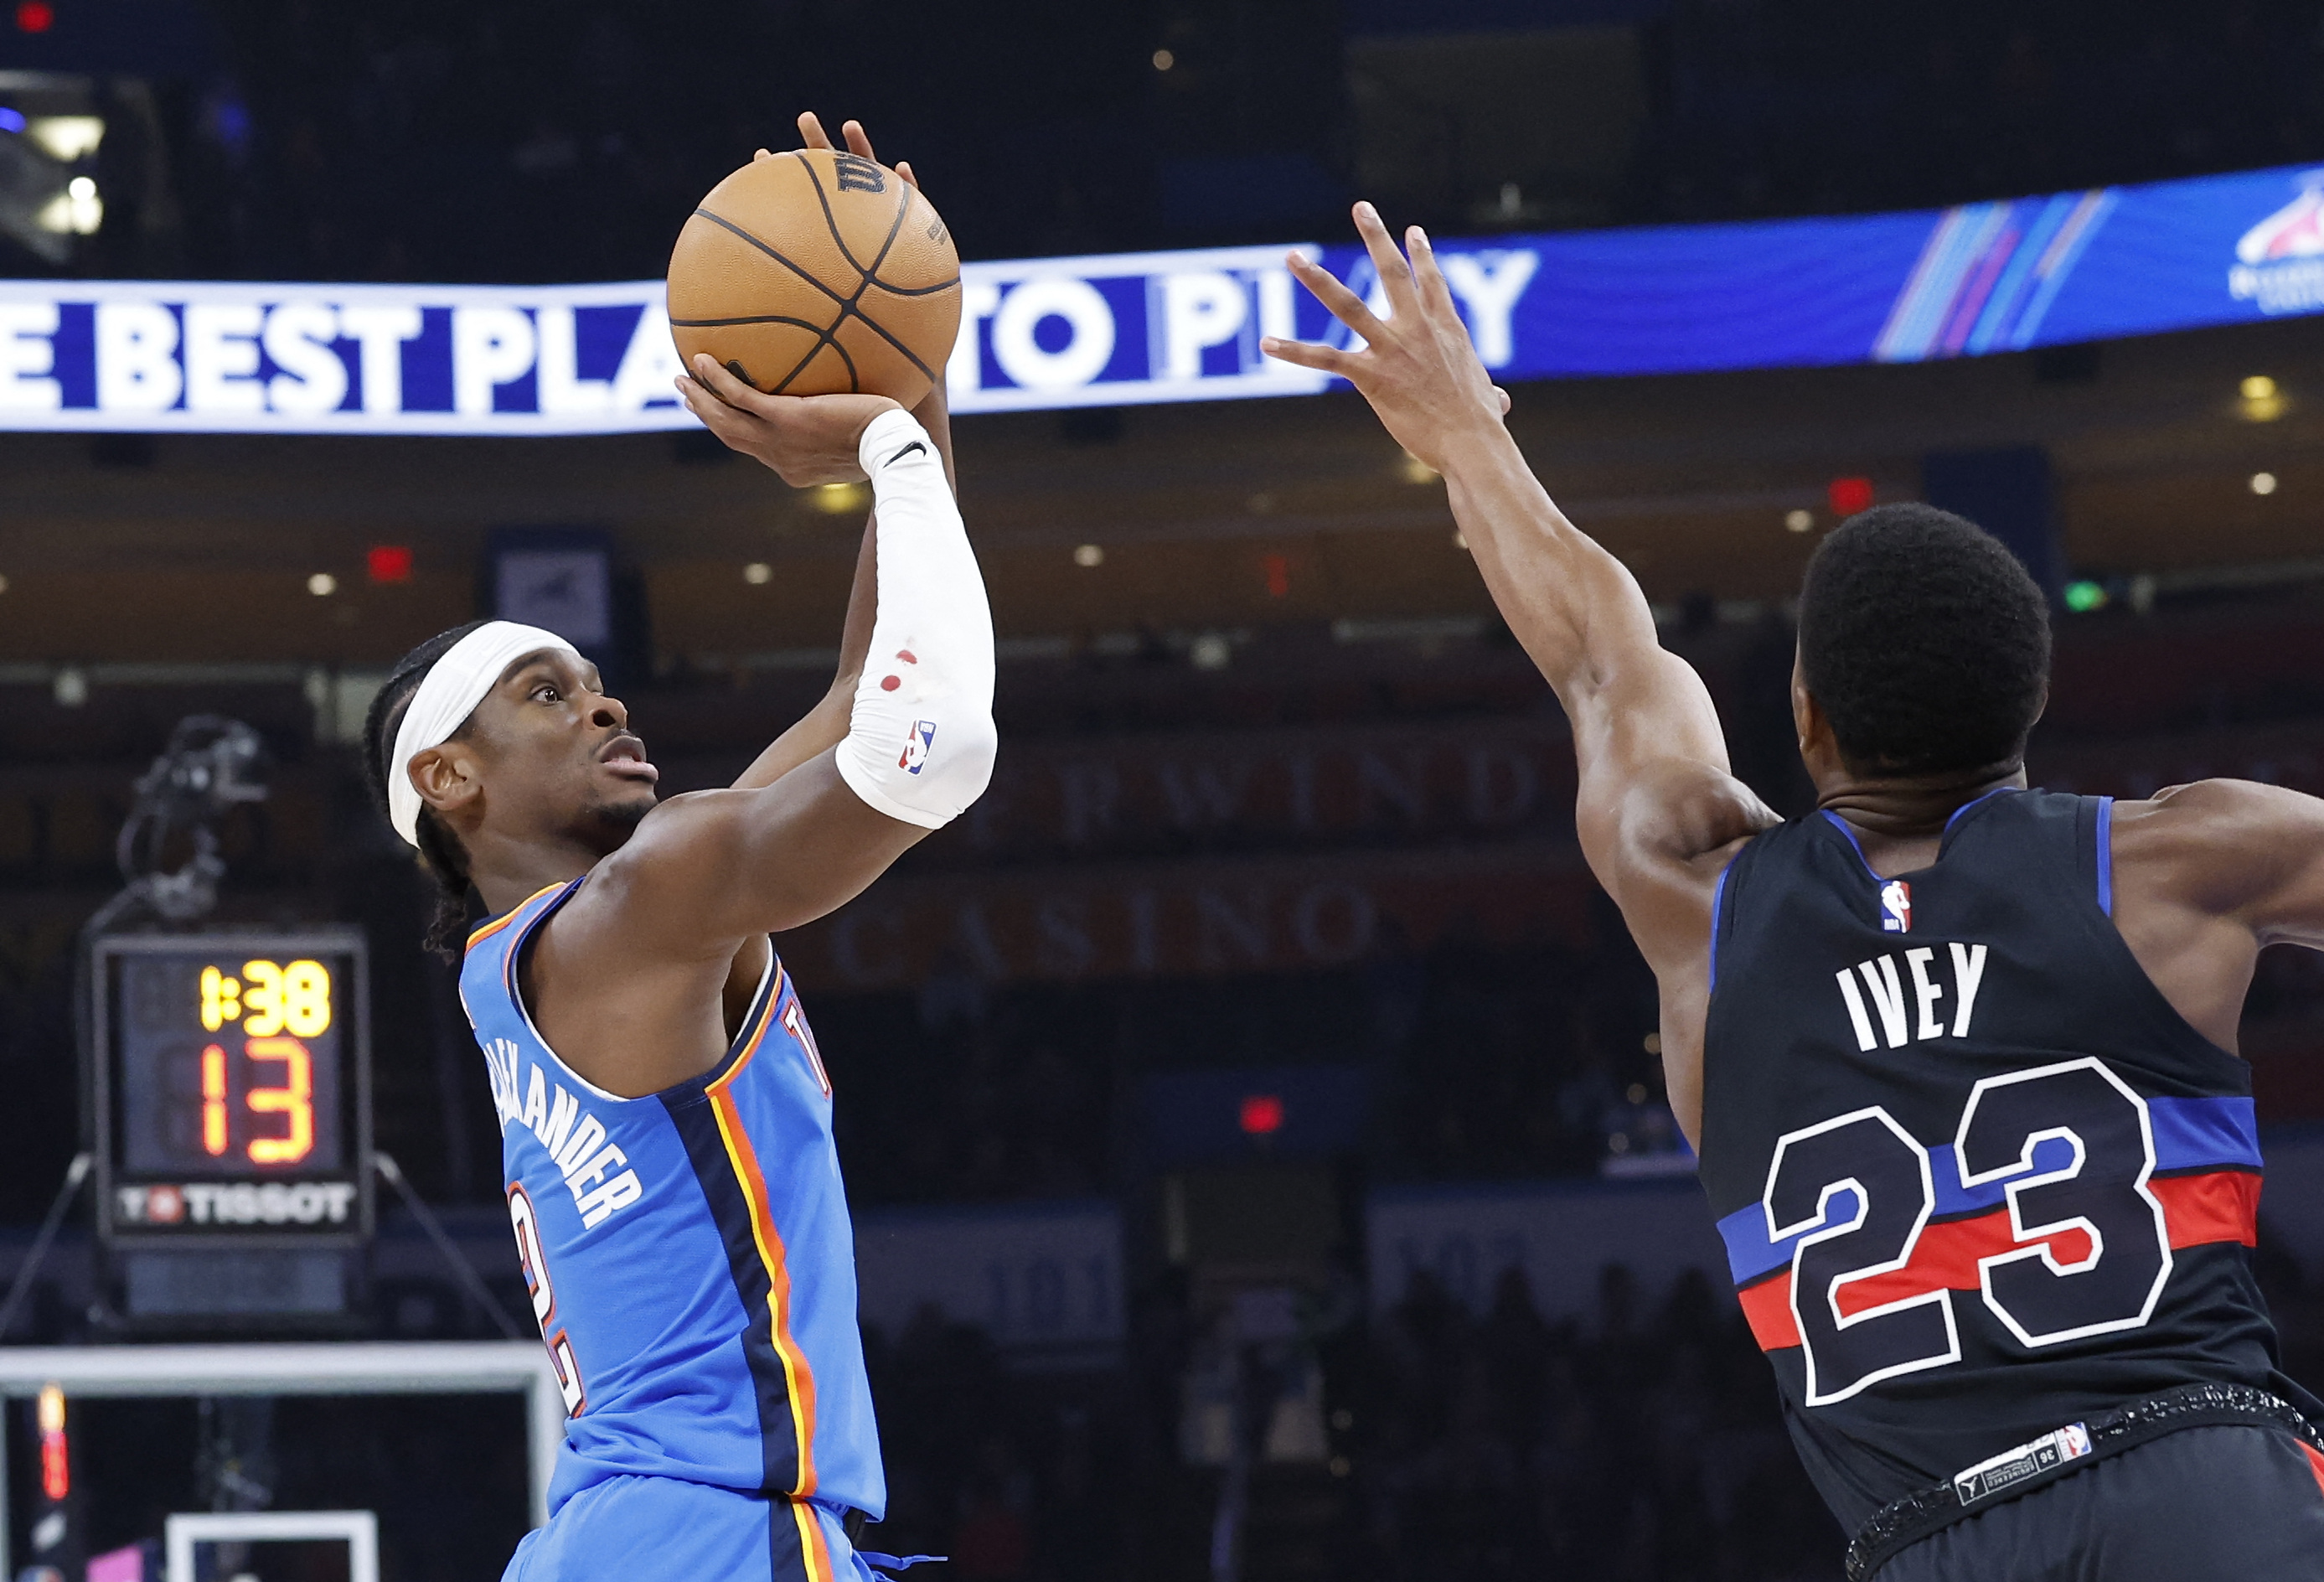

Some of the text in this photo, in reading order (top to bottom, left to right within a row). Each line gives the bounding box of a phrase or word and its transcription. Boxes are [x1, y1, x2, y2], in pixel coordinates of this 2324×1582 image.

[94, 302, 424, 414] BEST
[453, 302, 689, 416] PLA
[826, 881, 1377, 987] CASINO
[200, 959, 332, 1038] 1:38
[1836, 942, 1988, 1052] IVEY
[201, 1037, 315, 1165] 13
[183, 1182, 357, 1224] TISSOT
[1762, 1055, 2173, 1408] 23
[2040, 1450, 2055, 1464] 36
